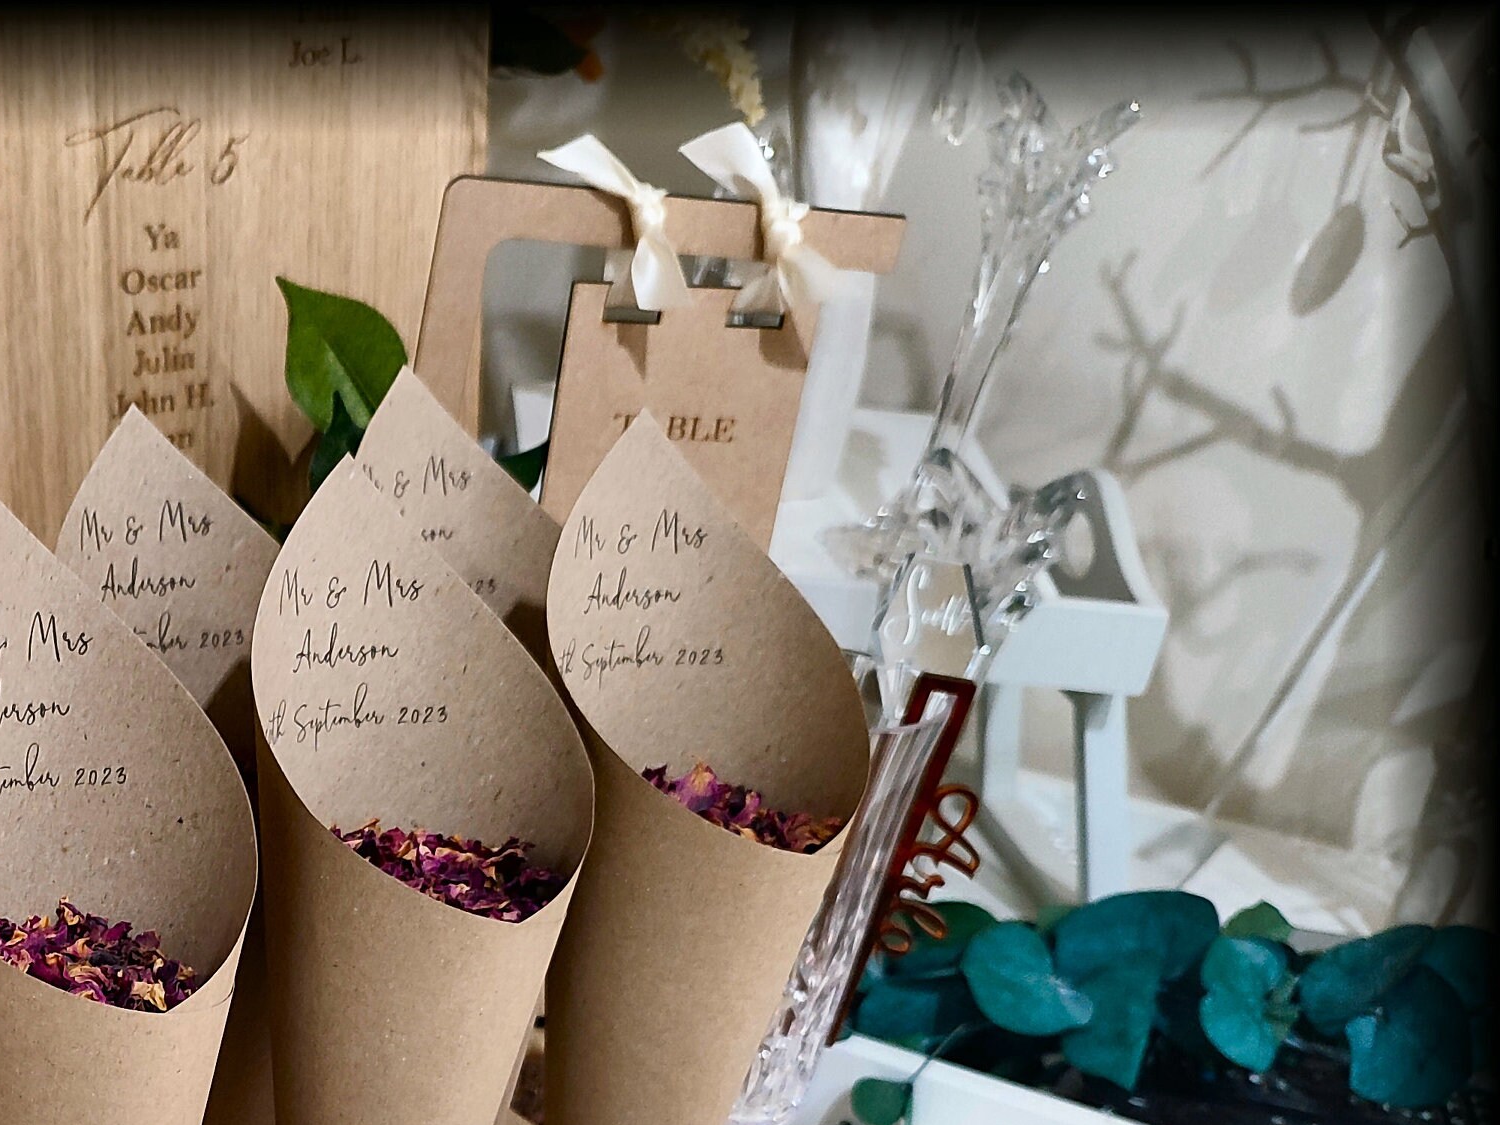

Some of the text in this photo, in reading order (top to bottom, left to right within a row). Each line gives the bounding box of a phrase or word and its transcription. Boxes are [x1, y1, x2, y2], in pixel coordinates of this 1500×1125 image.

[288, 40, 331, 68] Joe
[64, 106, 251, 226] Table 5
[119, 268, 202, 296] Oscar
[126, 303, 199, 340] Andy
[112, 389, 176, 420] Jhn
[612, 413, 736, 443] TBLE
[393, 469, 411, 499] &
[422, 455, 474, 497] Mrs
[80, 499, 215, 552] Mr & Mrs
[575, 508, 709, 560] Mr & Mrs
[100, 556, 196, 604] Anderson
[279, 559, 426, 616] Mr & Mrs
[583, 566, 682, 615] Anderson
[27, 611, 95, 662] Mrs
[199, 628, 245, 650] 2023
[293, 622, 400, 674] Anderson
[581, 624, 665, 690] September
[674, 648, 725, 667] 2023
[293, 682, 386, 753] September
[397, 704, 449, 726] 2023
[74, 767, 129, 788] 2023
